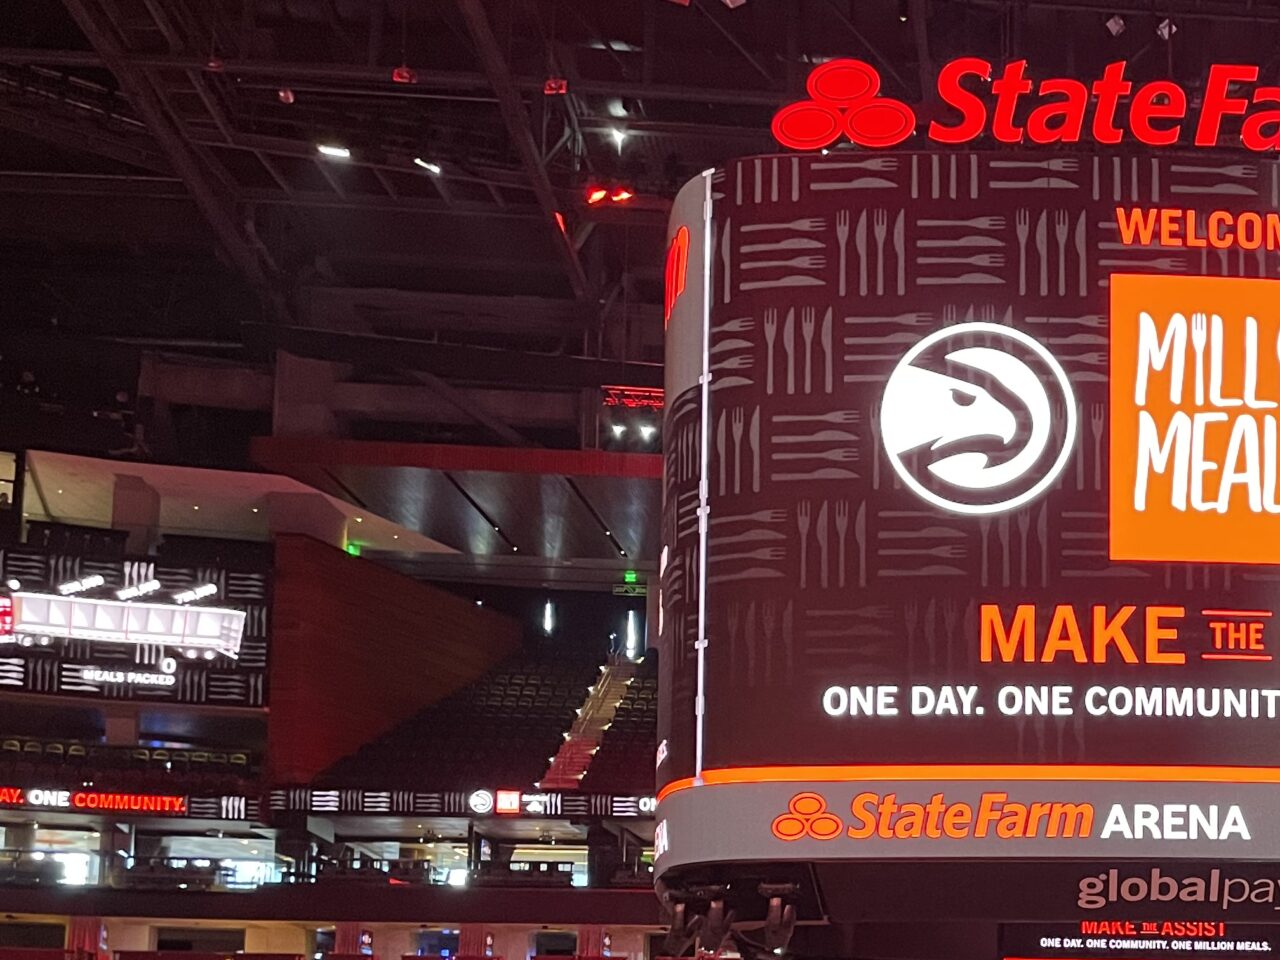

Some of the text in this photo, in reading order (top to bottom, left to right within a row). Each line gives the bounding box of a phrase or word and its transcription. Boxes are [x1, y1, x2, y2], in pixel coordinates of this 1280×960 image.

[979, 604, 1187, 665] MAKE
[1208, 620, 1265, 652] THE
[162, 658, 177, 674] 0
[83, 669, 176, 686] MEALS PACKED
[822, 685, 899, 717] ONE
[911, 685, 984, 716] DAY.
[998, 685, 1074, 716] ONE
[0, 788, 187, 812] AY. ONE COMMUNITY.
[1100, 803, 1251, 841] ARENA
[1081, 921, 1137, 935] MAKE
[1160, 921, 1225, 937] ASSIST
[1040, 937, 1272, 951] ONE DAY. ONE COMMUNITY. ONE MILLION MEALS.
